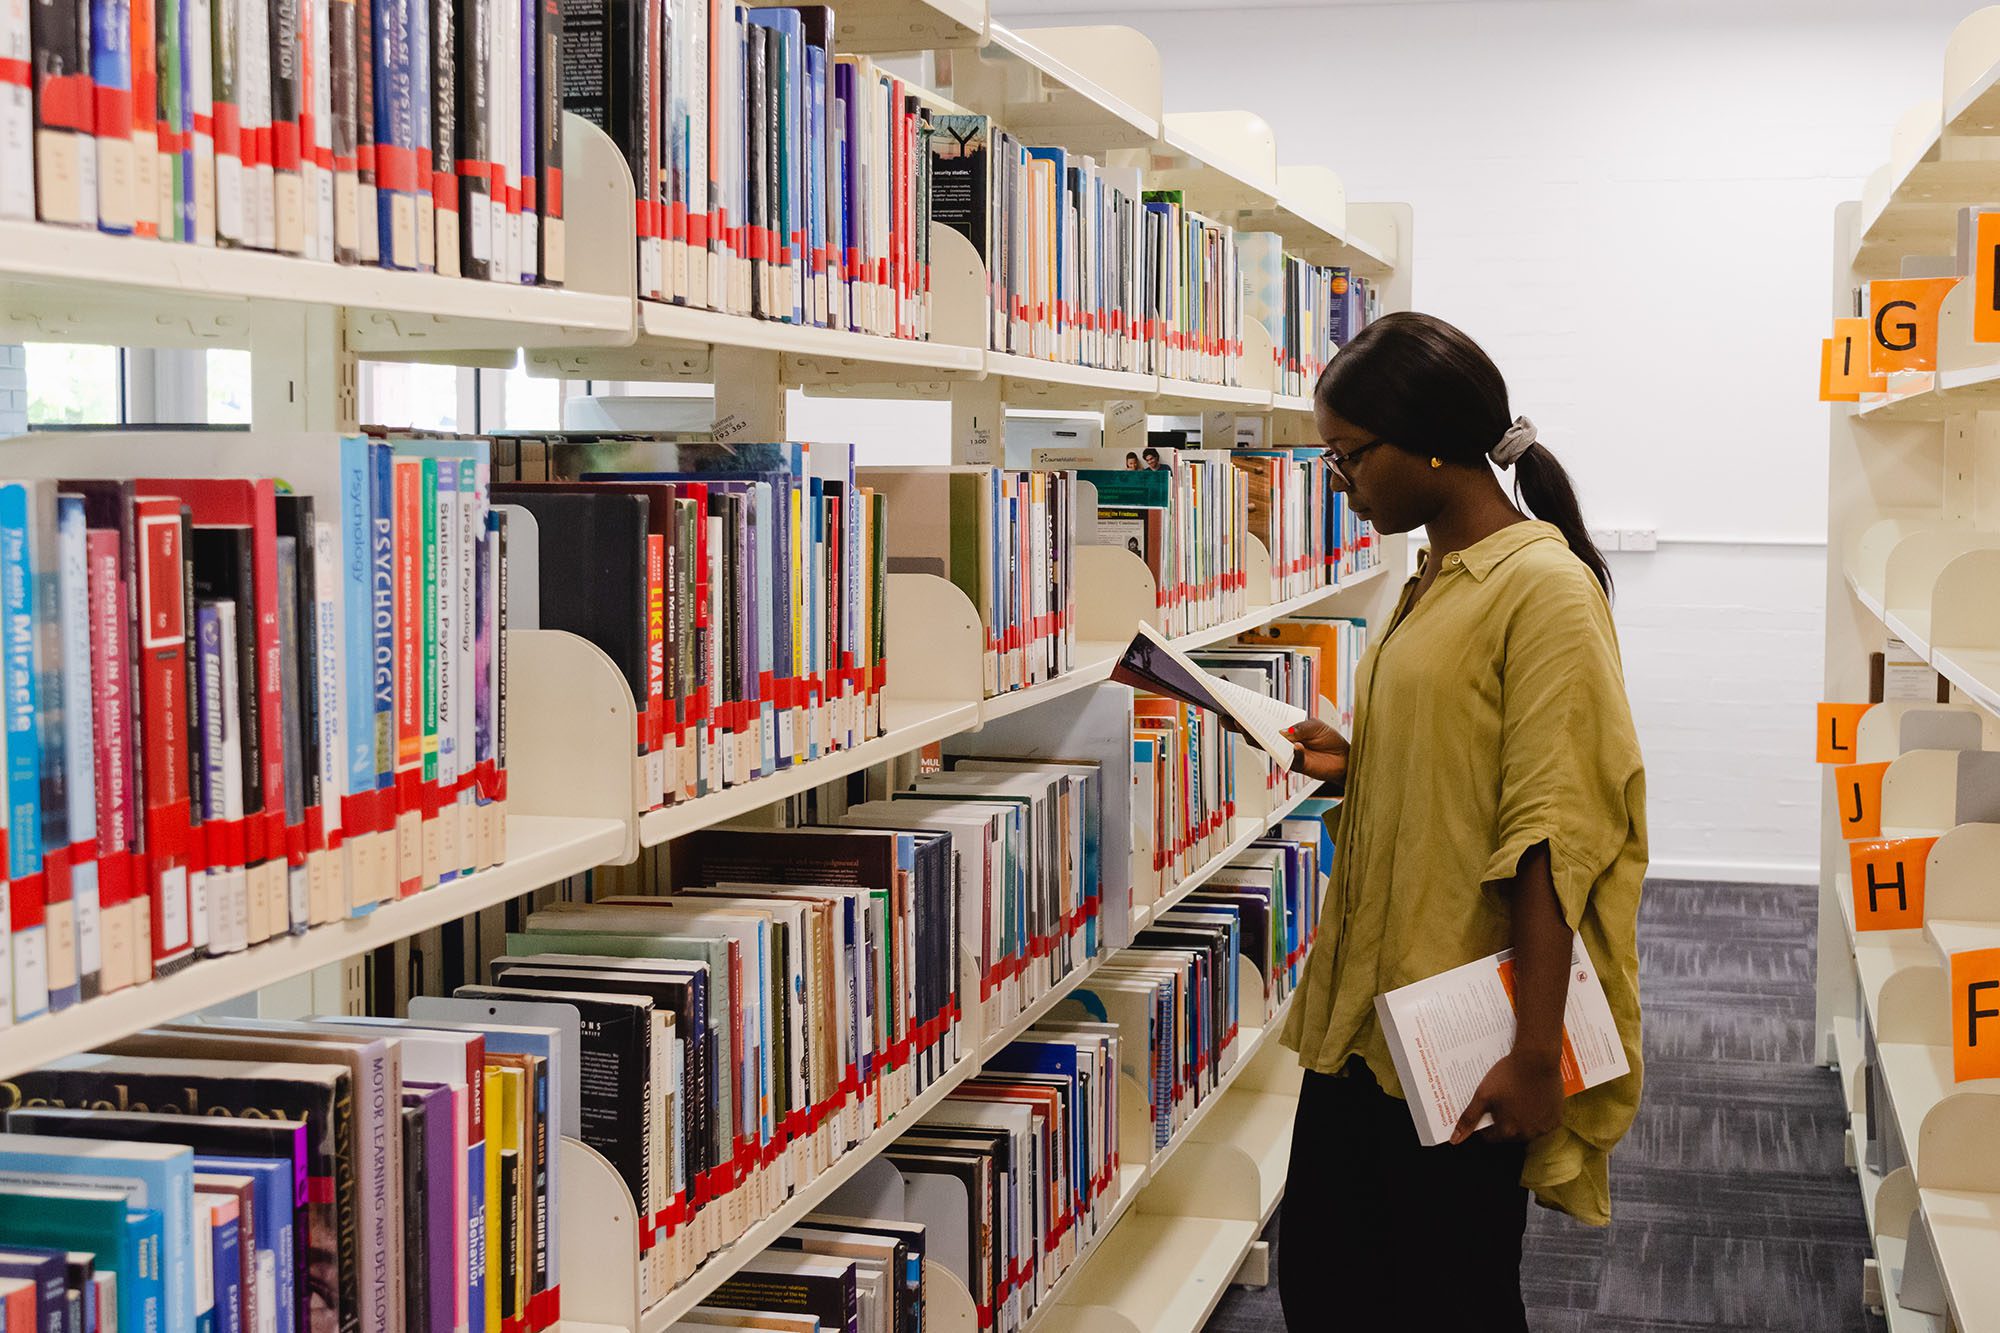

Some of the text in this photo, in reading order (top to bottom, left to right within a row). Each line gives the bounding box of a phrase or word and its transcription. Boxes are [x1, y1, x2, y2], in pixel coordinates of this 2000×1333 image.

[440, 76, 455, 172] SYSTEMS
[1844, 336, 1851, 376] I
[1874, 300, 1917, 351] G
[11, 529, 25, 564] The
[351, 469, 366, 584] Psychology
[404, 554, 413, 622] Statistics
[428, 544, 437, 580] SPSS
[462, 503, 473, 653] SPSS in Psychology
[500, 558, 508, 609] Methods
[103, 556, 118, 656] REPORTING
[374, 519, 392, 703] PSYCHOLOGY
[428, 583, 437, 642] Statistics
[438, 503, 452, 723] Statistics in Psychology
[668, 546, 676, 699] Social Media Fuchs
[12, 615, 35, 733] Miracle
[107, 661, 119, 679] IN
[109, 684, 120, 695] A
[321, 602, 334, 783] POPULAR PSYCHOLOGY
[402, 644, 414, 725] Psychology
[426, 660, 438, 728] Psychology
[500, 631, 508, 696] Behavioral
[164, 669, 176, 740] News and
[205, 652, 222, 762] Educational
[500, 698, 508, 758] Research
[1831, 717, 1849, 751] L
[109, 699, 123, 807] MULTIMEDIA
[113, 808, 125, 852] WOR
[1848, 783, 1862, 823] J
[1866, 861, 1908, 913] H
[1968, 980, 1999, 1048] F
[372, 1057, 385, 1121] MOTOR
[473, 1070, 482, 1125] CHANCE
[697, 1032, 705, 1131] Footprints
[1420, 1049, 1433, 1082] Queensland
[1435, 1074, 1445, 1100] Australia
[1437, 1101, 1448, 1127] Criminal
[1443, 1100, 1454, 1125] Western
[373, 1125, 386, 1212] LEARNING
[641, 1080, 651, 1217] COMMEMORATIONS
[246, 1240, 255, 1284] Doing
[375, 1217, 386, 1246] AND
[469, 1217, 480, 1287] Behavior
[537, 1250, 546, 1273] OUT
